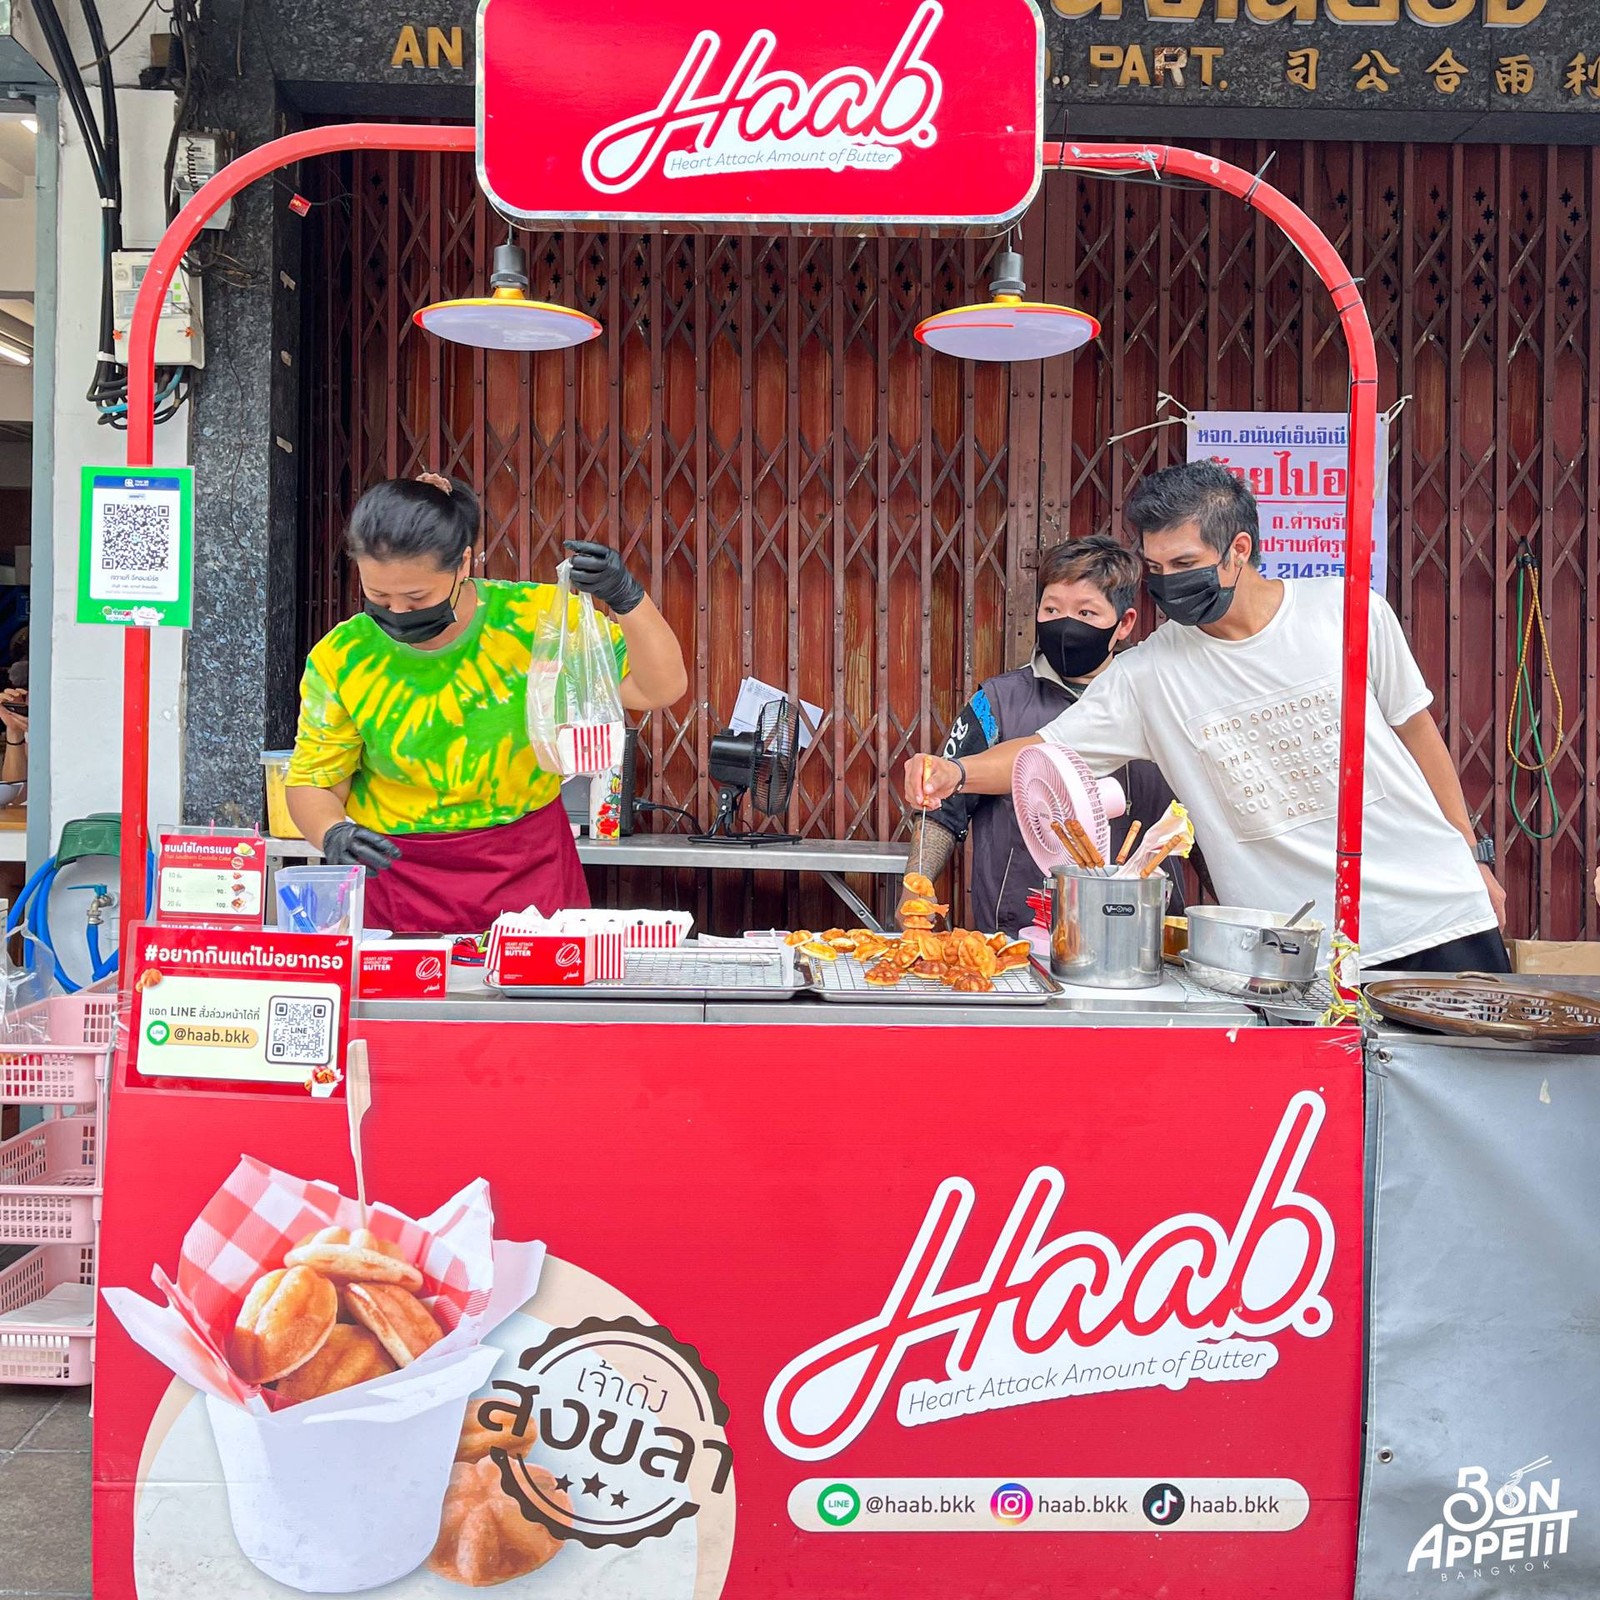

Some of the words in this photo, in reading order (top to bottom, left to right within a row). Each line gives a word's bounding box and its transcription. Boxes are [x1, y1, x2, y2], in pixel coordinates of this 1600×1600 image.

[1088, 44, 1229, 89] PART.
[670, 156, 712, 172] Heart
[714, 151, 763, 167] Attack
[766, 148, 825, 164] Amount
[828, 147, 846, 165] of
[847, 148, 895, 164] Butter
[1198, 425, 1347, 446] หจก.อนันต์เอ็นจิเนี
[1272, 512, 1347, 530] ถ.ดำรงรั
[1203, 718, 1241, 740] FIND
[1250, 687, 1336, 725] SOMEONE
[1218, 730, 1260, 752] WHO
[1266, 707, 1332, 736] KNOWS
[1219, 746, 1261, 769] THAT
[1267, 736, 1302, 752] YOU
[1229, 762, 1266, 784] NOT
[1244, 776, 1274, 797] BUT
[1234, 796, 1271, 816] YOU
[1279, 786, 1298, 803] AS
[144, 944, 343, 970] #อยากกินแต่ไม่อยากรอ
[170, 1007, 196, 1018] LINE
[174, 1028, 250, 1044] @haab.bkk
[290, 1026, 308, 1035] LINE
[577, 1360, 669, 1413] เจ้าดัง
[909, 1383, 975, 1415] Heart
[979, 1367, 1057, 1400] Attack
[1061, 1356, 1157, 1386] Amount
[1162, 1350, 1190, 1378] of
[1191, 1349, 1267, 1372] Butter
[477, 1380, 735, 1495] สงขลา
[828, 1499, 850, 1508] LINE
[866, 1495, 976, 1514] @haab.bkk
[1038, 1494, 1128, 1513] haab.bkk
[1190, 1494, 1280, 1513] haab.bkk
